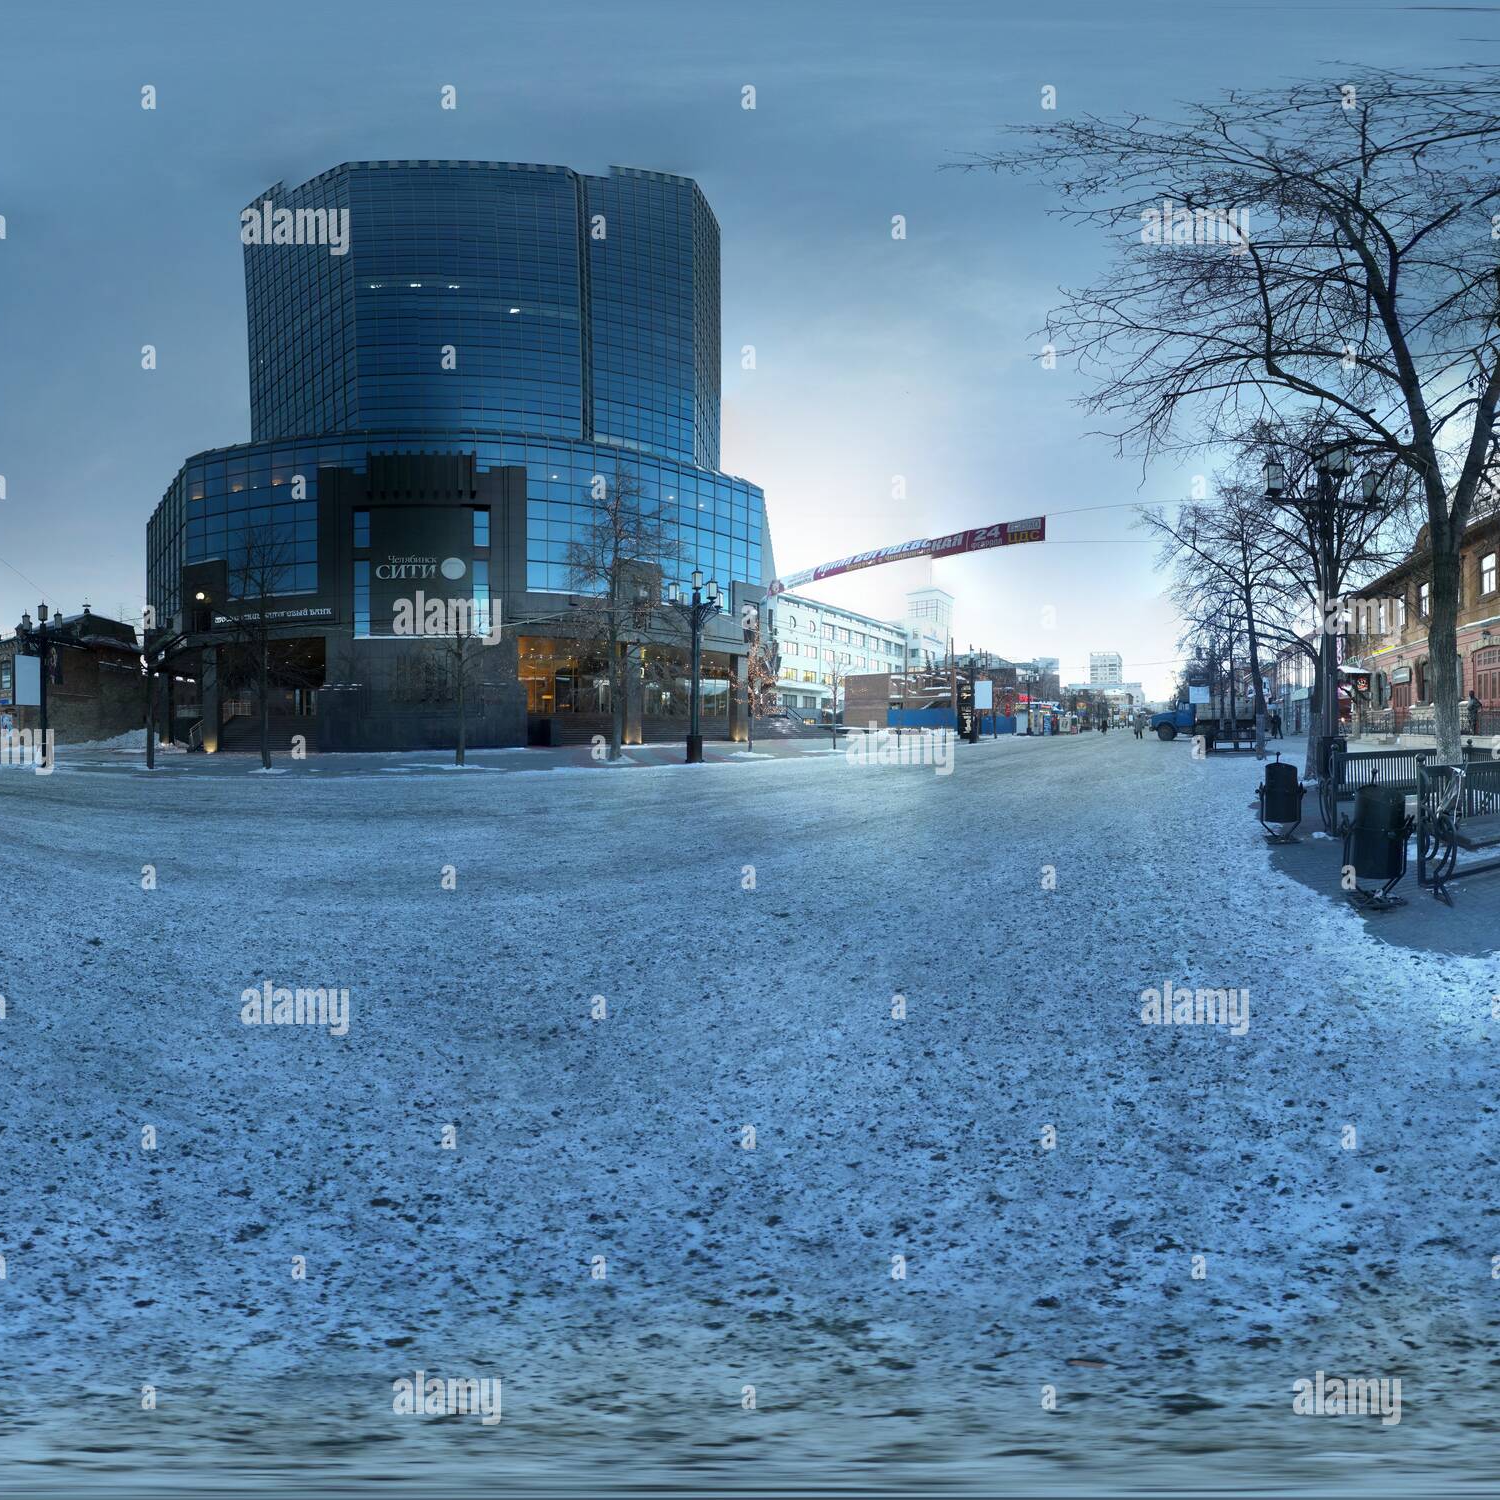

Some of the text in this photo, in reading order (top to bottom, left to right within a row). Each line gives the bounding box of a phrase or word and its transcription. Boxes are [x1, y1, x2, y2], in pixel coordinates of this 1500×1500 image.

[974, 526, 1001, 541] 24
[388, 555, 437, 564] Челябинск
[375, 564, 437, 580] СИТИ
[309, 607, 332, 616] БАНК
